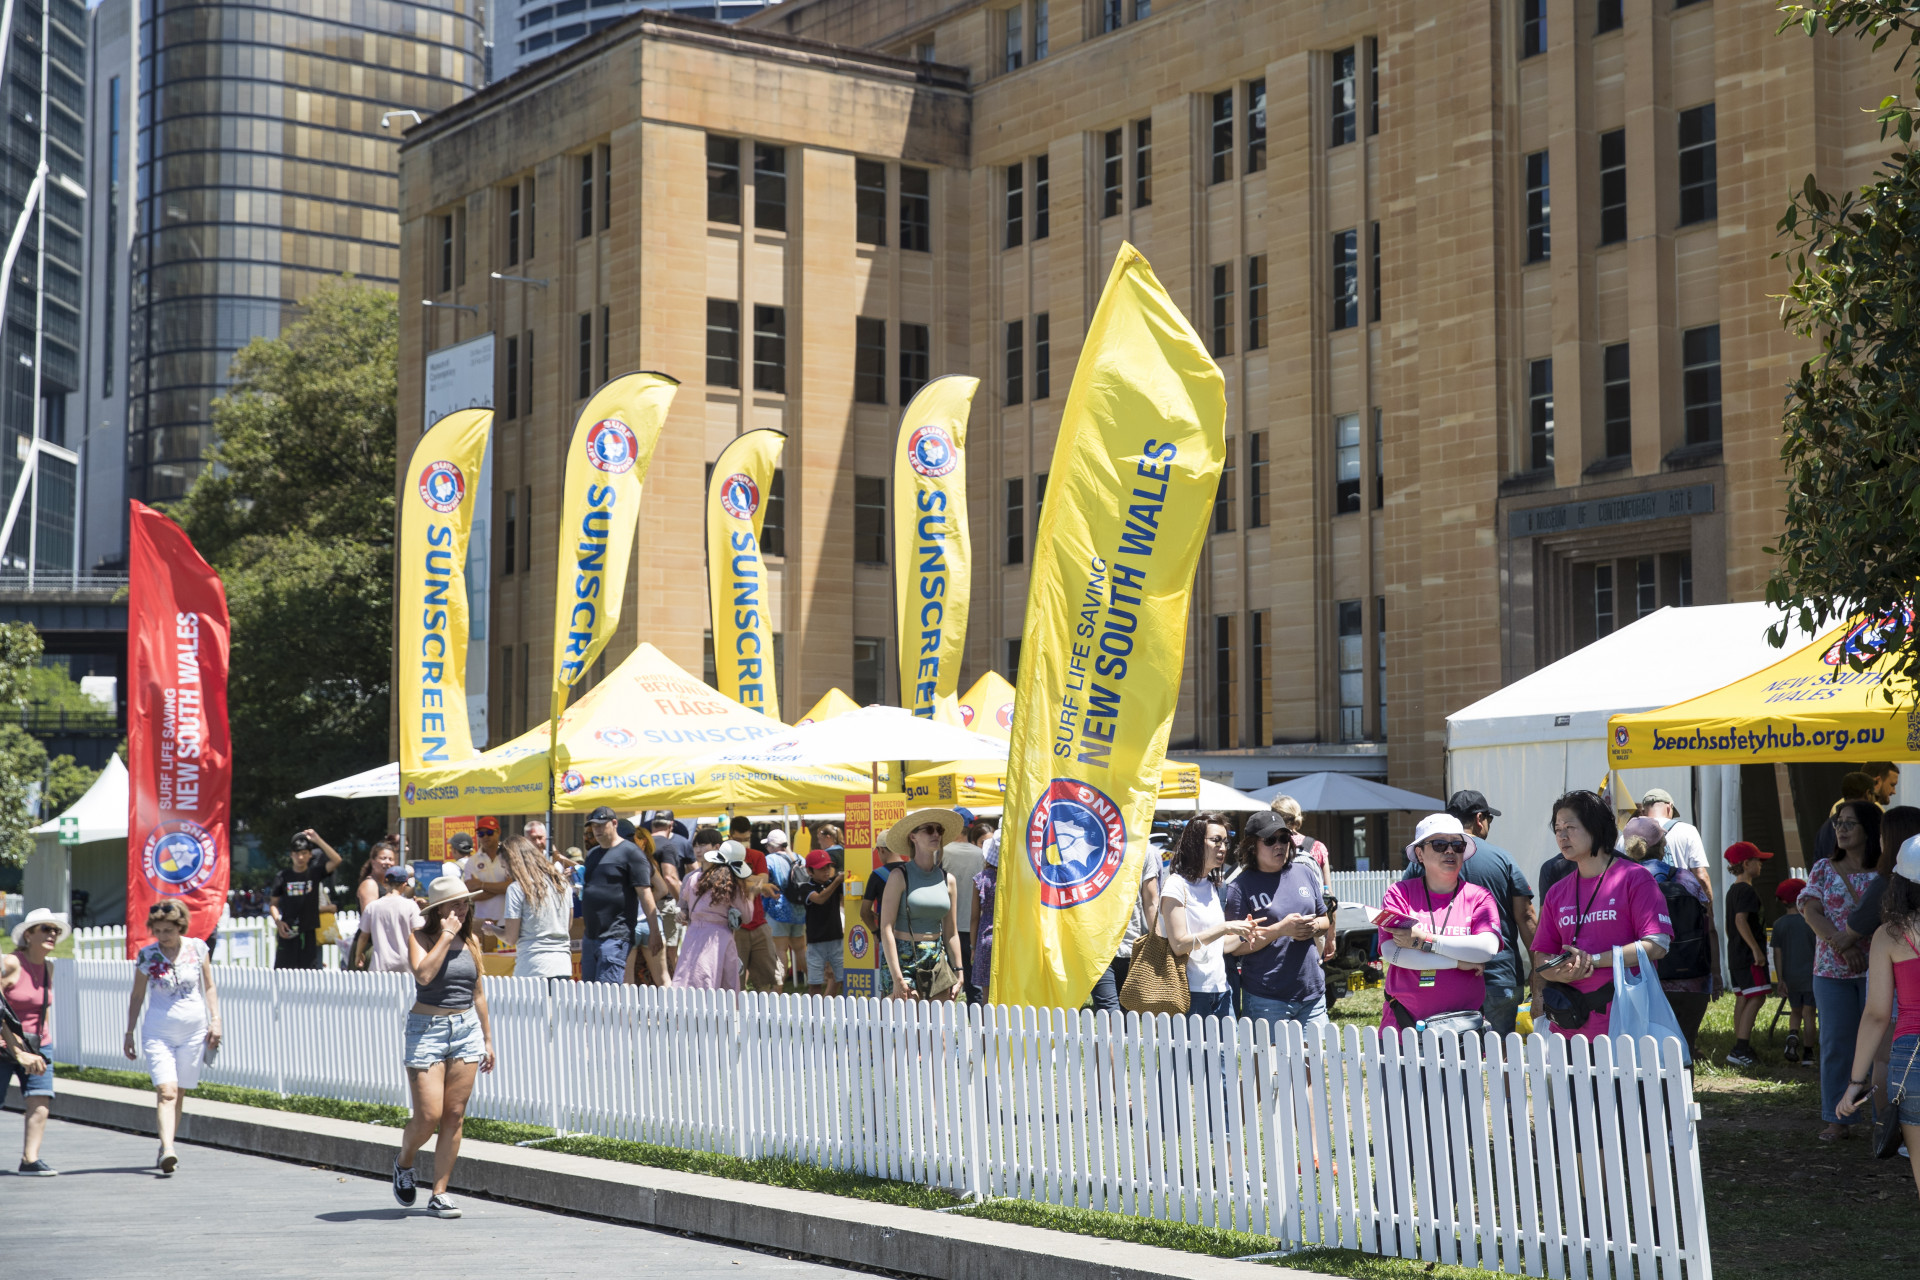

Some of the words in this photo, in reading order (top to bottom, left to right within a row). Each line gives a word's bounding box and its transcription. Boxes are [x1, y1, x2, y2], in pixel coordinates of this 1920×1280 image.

[602, 420, 633, 439] SURF
[431, 461, 459, 474] SURF
[587, 441, 601, 466] LIFE
[420, 485, 436, 506] LIFE
[732, 474, 755, 488] SURF
[721, 495, 737, 516] LIFE
[1117, 438, 1177, 556] WALES
[1577, 507, 1587, 523] OF
[1669, 491, 1685, 512] ART
[558, 484, 617, 681] SUNSCRE
[1076, 556, 1107, 639] SAVING
[731, 531, 765, 714] SUNSCRE
[1095, 563, 1146, 680] SOUTH
[176, 611, 200, 685] WALES
[421, 523, 452, 762] SUNSCREEN
[1066, 642, 1091, 692] LIFE
[1761, 674, 1817, 692] NEW
[1811, 672, 1891, 686] SOUTH
[639, 682, 710, 697] BEYOND
[1764, 688, 1843, 704] WALES
[162, 687, 176, 738] SAVING
[653, 699, 729, 716] FLAGS
[177, 690, 201, 759] SOUTH
[643, 726, 784, 743] SUNSCR
[1054, 696, 1082, 758] SURF
[1077, 685, 1122, 769] NEW
[1653, 723, 1885, 755] beachsafetyhub.org.au
[161, 740, 175, 770] LIFE
[160, 772, 174, 810] SURF
[176, 760, 199, 811] NEW
[589, 772, 695, 790] SUNSCREEN
[710, 772, 726, 781] SPF
[729, 772, 746, 781] 50+
[863, 773, 890, 782] FLGS
[846, 809, 870, 822] BEYOND
[873, 800, 905, 809] PROTECTION
[873, 808, 905, 821] BEYOND
[846, 828, 870, 846] FLAGS
[1077, 786, 1121, 866] SAVING
[143, 835, 156, 879] SURF
[180, 823, 215, 866] SAVING
[179, 868, 210, 893] LIFE
[1059, 871, 1110, 905] LIFE
[1249, 892, 1273, 911] 10
[1415, 922, 1471, 936] OLUNTEE
[846, 973, 872, 988] FREE
